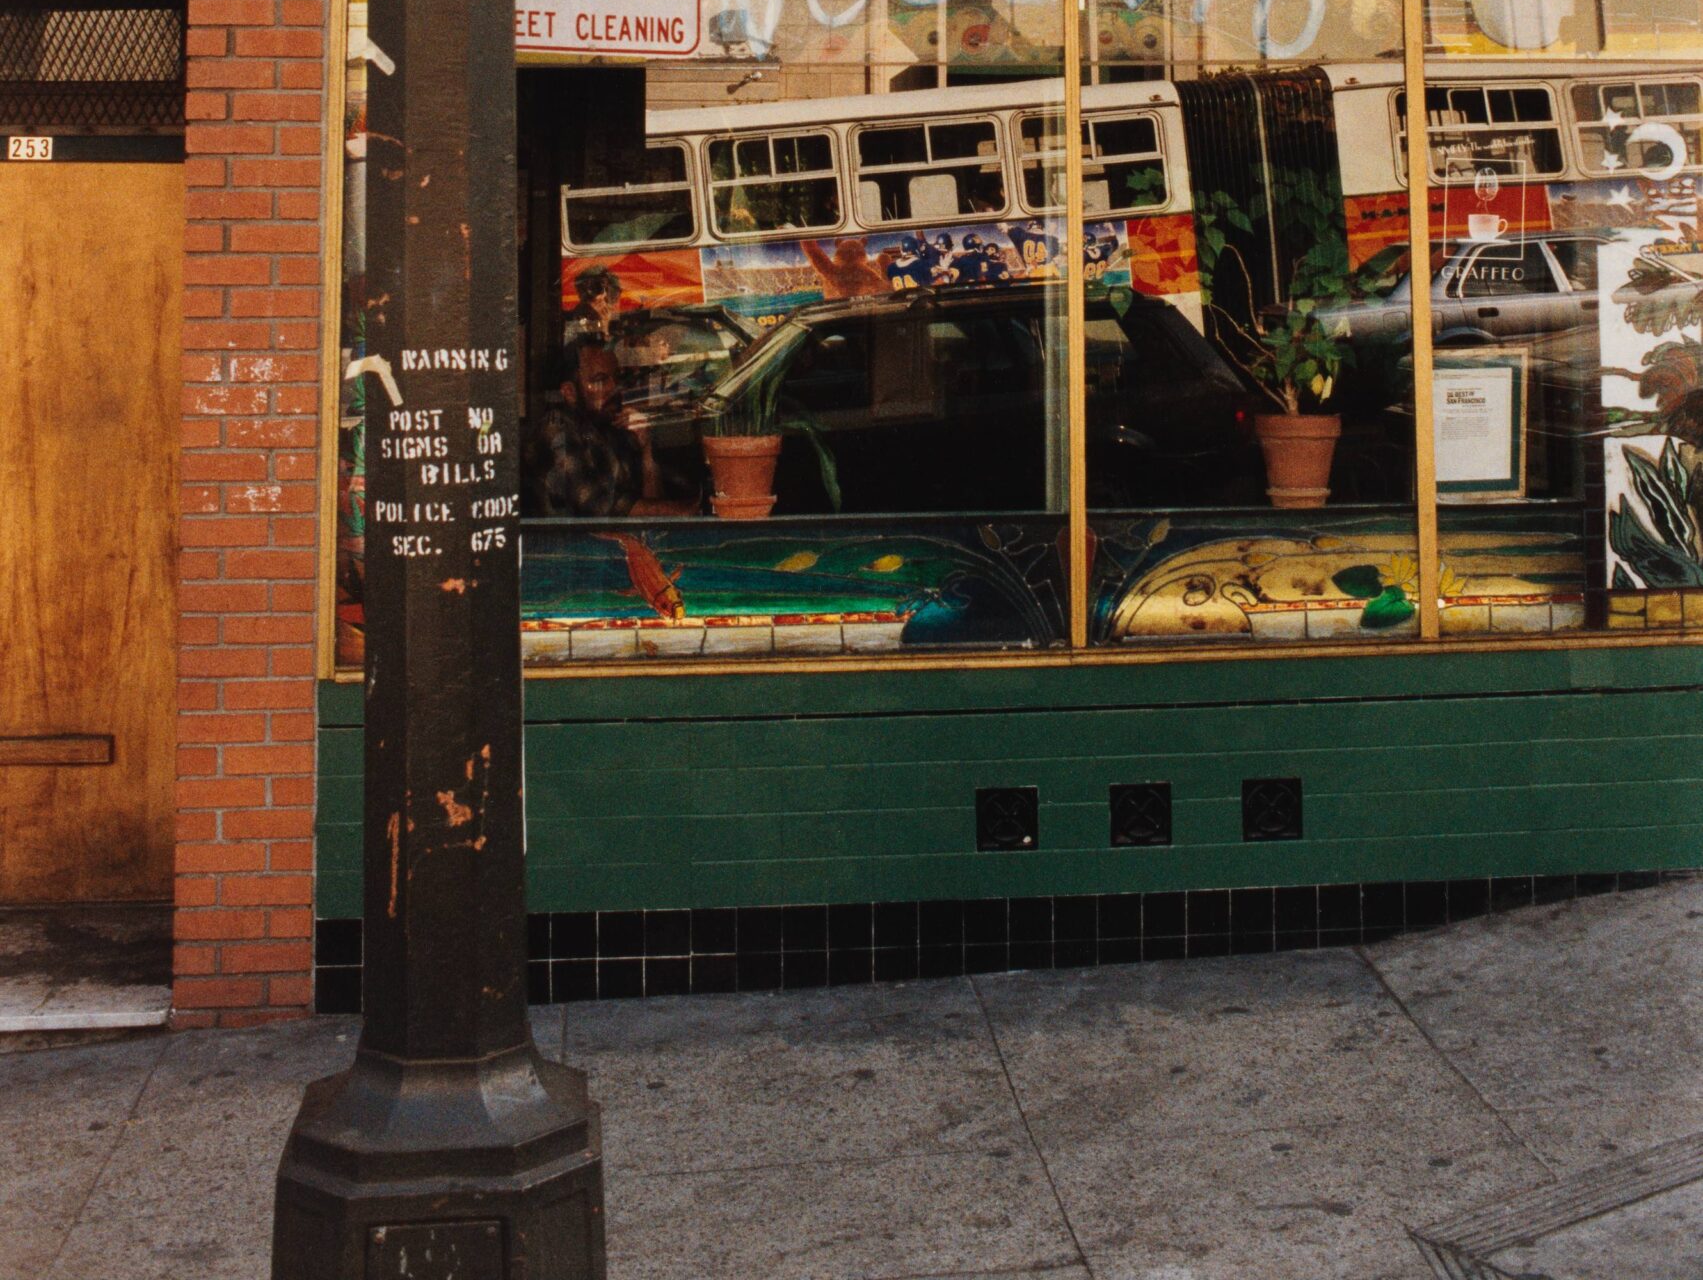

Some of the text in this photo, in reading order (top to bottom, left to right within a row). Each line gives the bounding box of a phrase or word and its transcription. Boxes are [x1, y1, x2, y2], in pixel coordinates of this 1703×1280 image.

[576, 13, 684, 45] CLEANING
[12, 138, 49, 158] 253
[1440, 265, 1525, 282] GRAFFEO
[402, 348, 508, 371] WARNING
[390, 407, 493, 431] POST NO
[478, 432, 502, 455] OR
[421, 460, 496, 484] BILLS
[375, 494, 519, 522] POLICE CODE
[392, 528, 506, 557] SEC. 675
